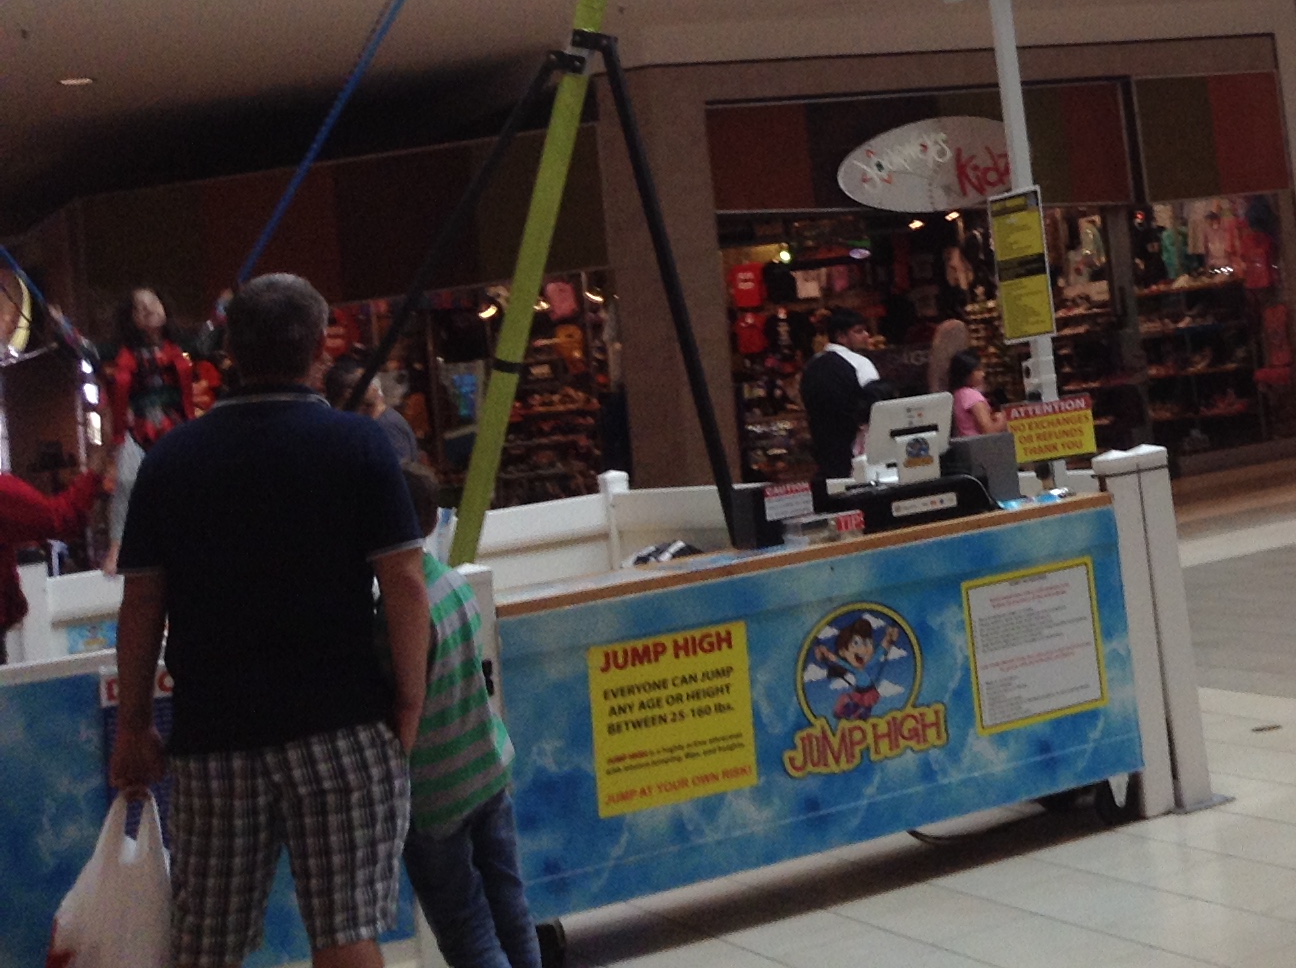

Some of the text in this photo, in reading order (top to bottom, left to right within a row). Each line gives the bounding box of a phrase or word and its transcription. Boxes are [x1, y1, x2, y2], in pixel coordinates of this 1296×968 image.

[1010, 397, 1086, 419] ATTENTION
[600, 629, 733, 673] JUMP HIGH
[603, 665, 734, 701] EVERYONE CAN JUMP
[608, 682, 731, 717] ANY AGE OR HEIGHT
[607, 712, 667, 735] BETWEEN
[788, 709, 942, 773] JUMP HIGH
[605, 789, 637, 805] JUMP
[657, 777, 689, 793] YOUR
[692, 772, 720, 786] OWN
